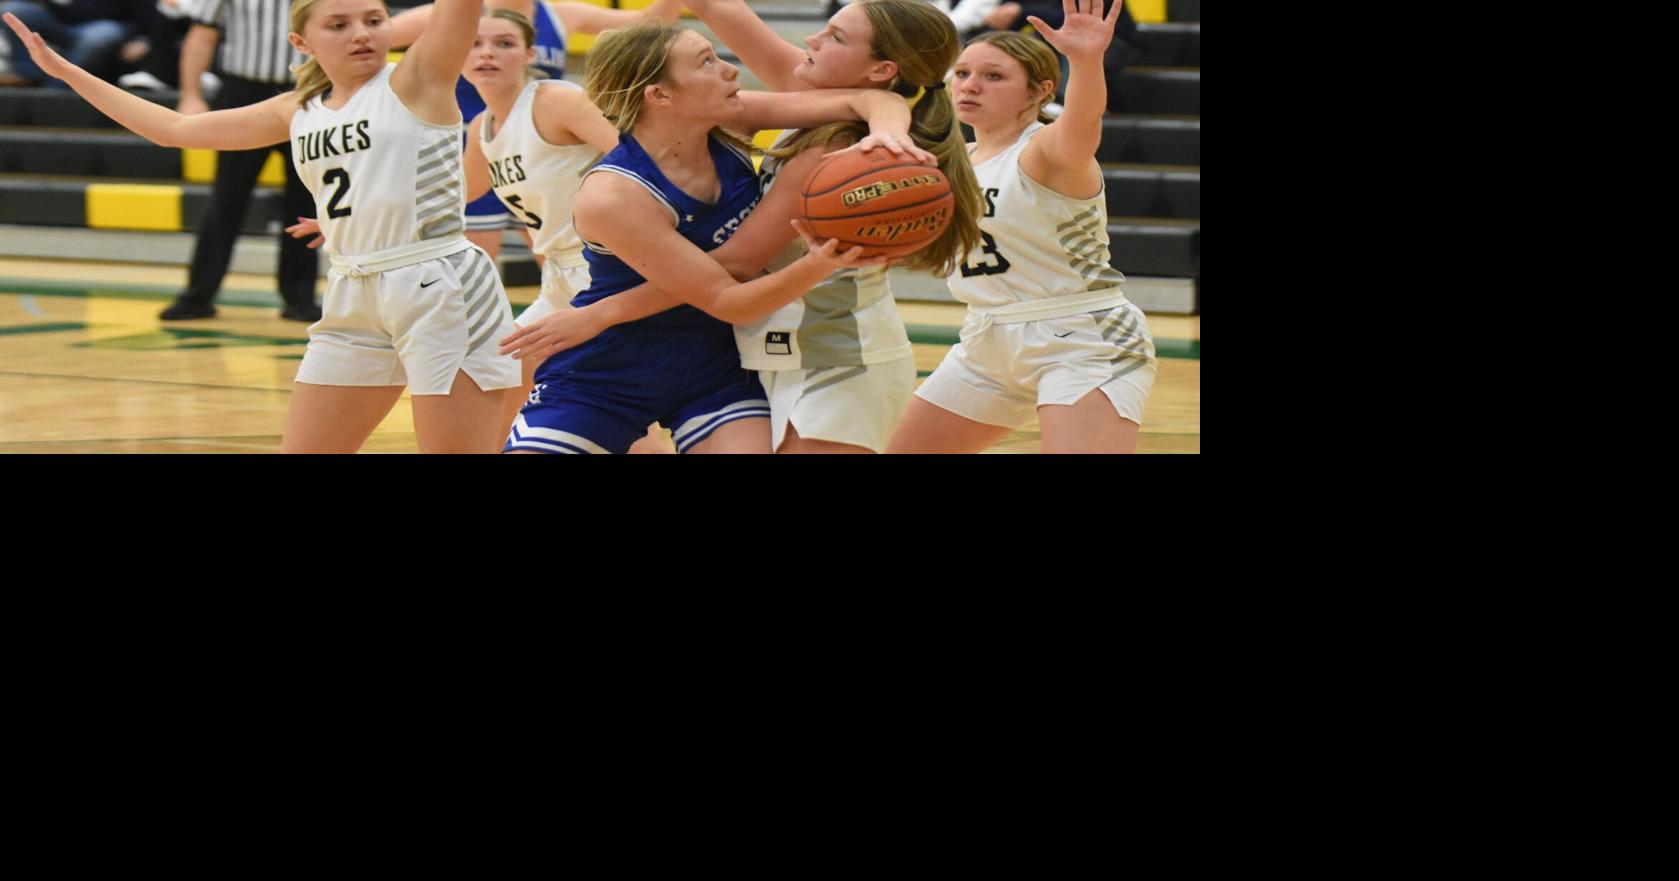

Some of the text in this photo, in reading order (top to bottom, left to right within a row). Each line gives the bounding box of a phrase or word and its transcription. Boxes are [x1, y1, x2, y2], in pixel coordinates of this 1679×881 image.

[298, 119, 371, 165] DUKES
[322, 167, 352, 220] 2
[843, 175, 941, 207] ELITE PRO
[771, 334, 782, 343] M
